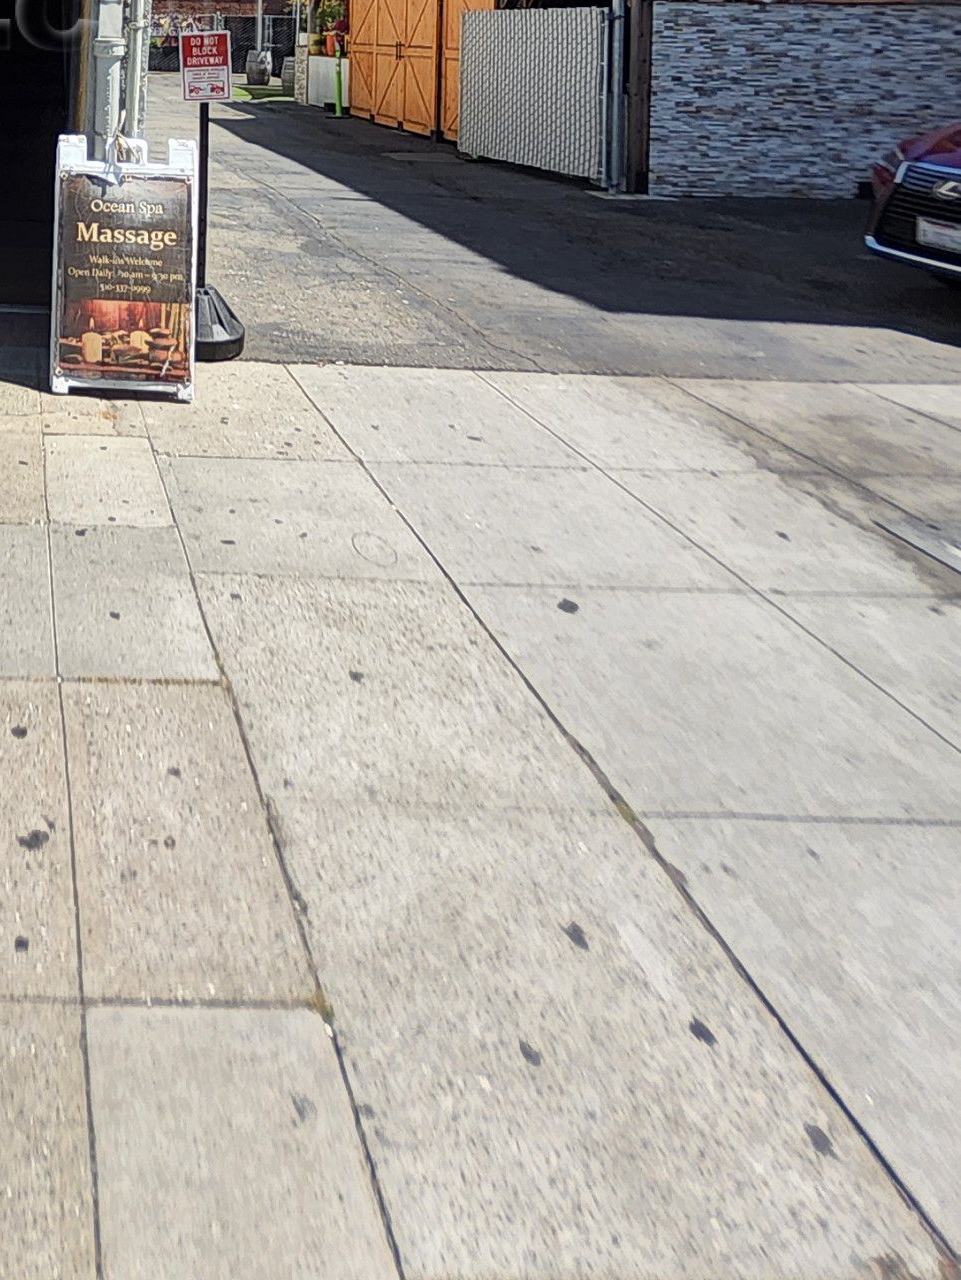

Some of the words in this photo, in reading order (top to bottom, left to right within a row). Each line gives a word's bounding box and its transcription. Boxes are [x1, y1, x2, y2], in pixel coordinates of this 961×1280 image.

[190, 37, 201, 46] DO
[203, 36, 218, 45] NOT
[192, 47, 218, 56] BLOCK
[187, 56, 224, 66] DRIVEWAY
[91, 200, 135, 213] Ocean
[139, 201, 164, 217] Spa
[77, 222, 177, 251] Massage
[125, 256, 163, 267] Welcome
[68, 267, 90, 277] Open
